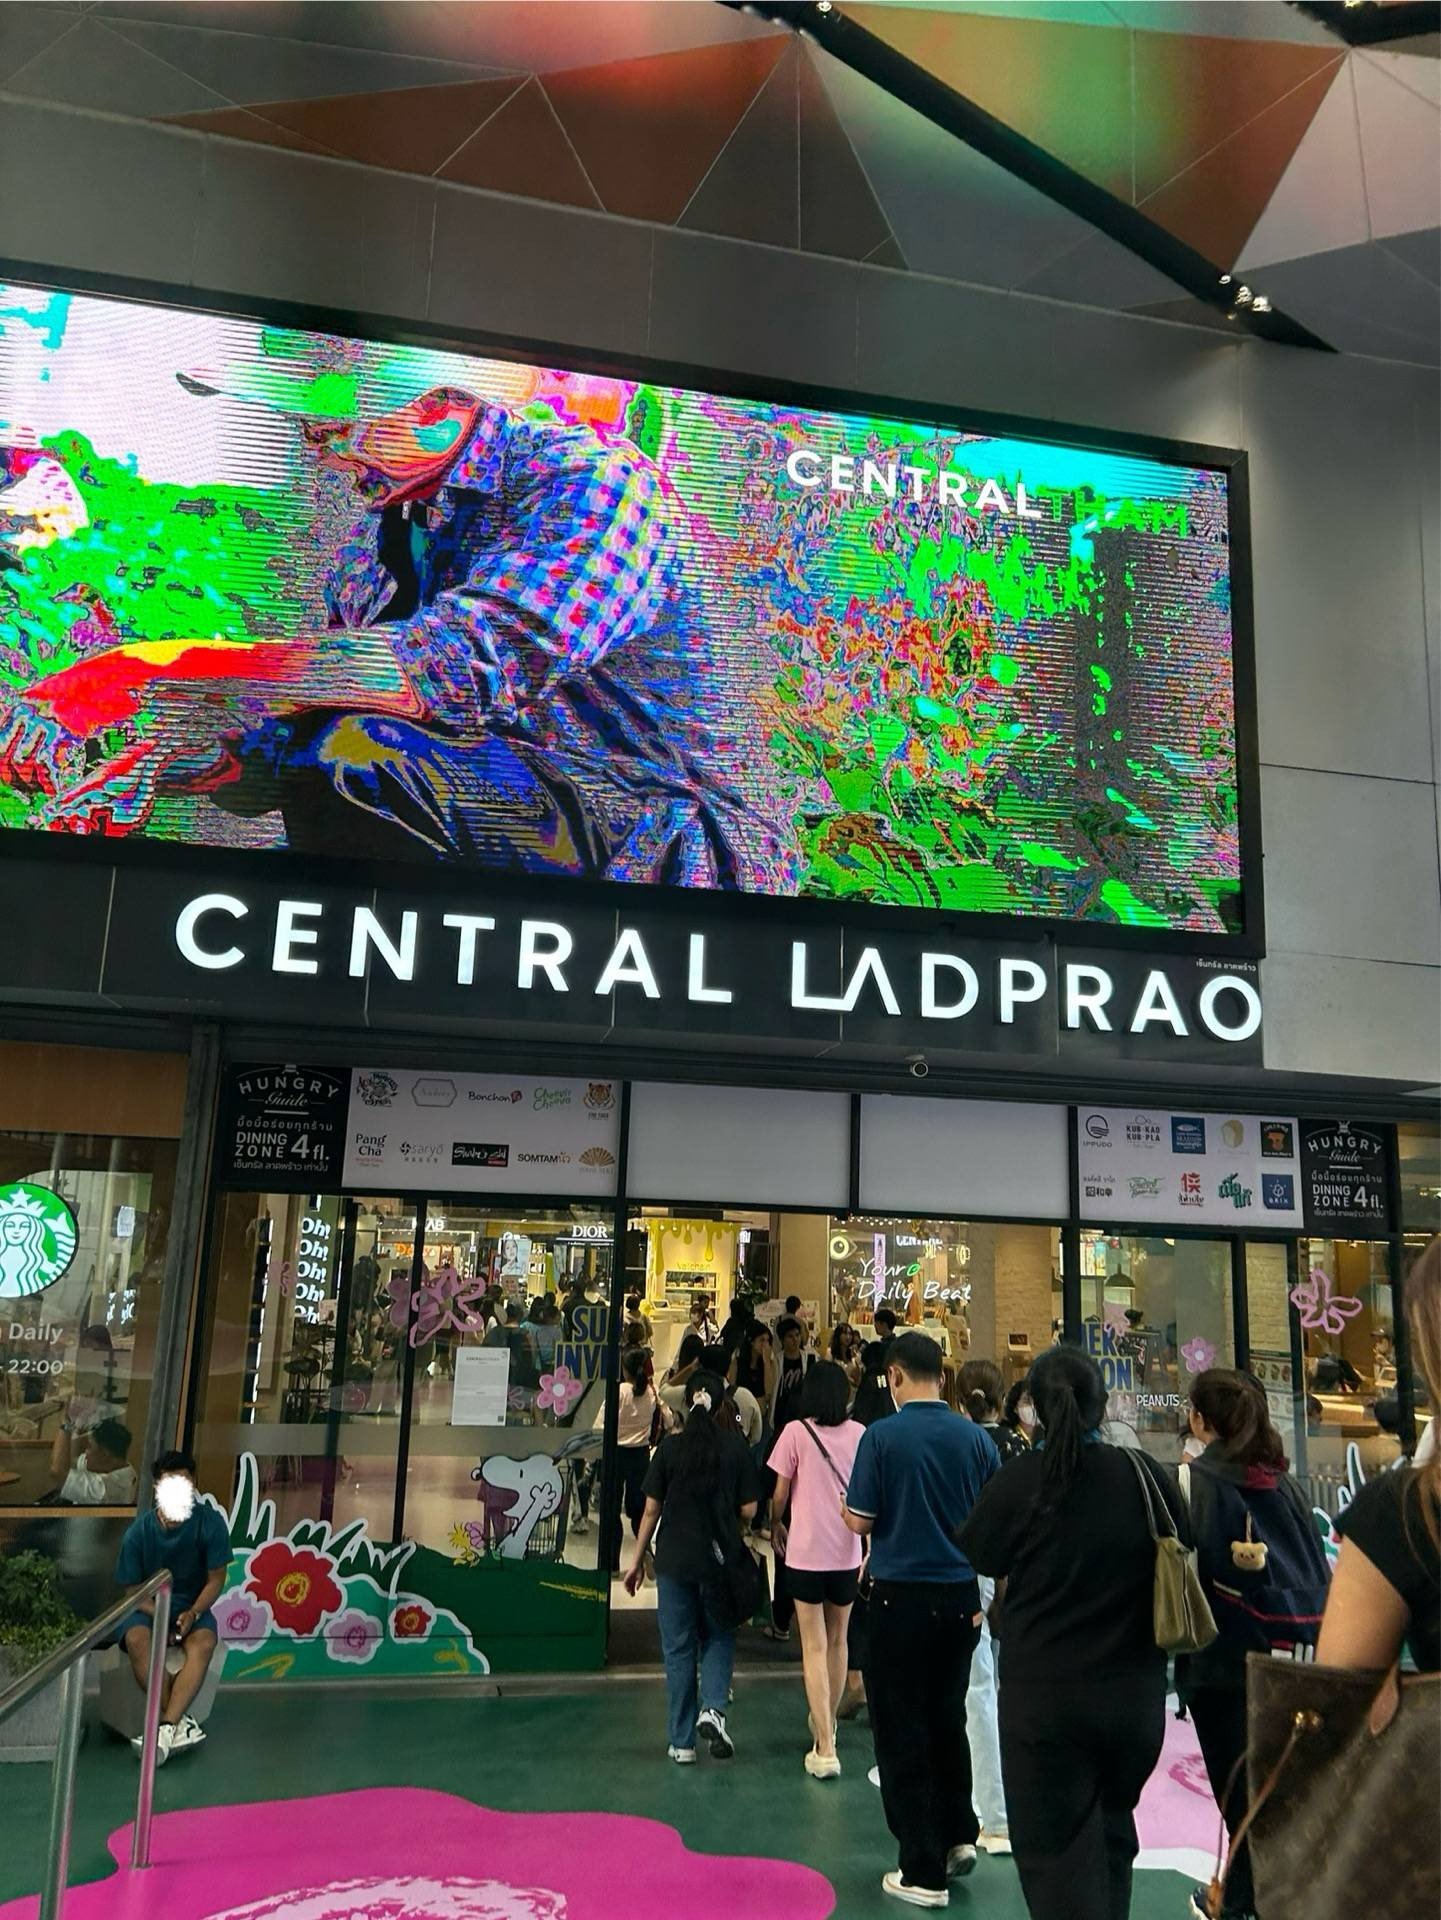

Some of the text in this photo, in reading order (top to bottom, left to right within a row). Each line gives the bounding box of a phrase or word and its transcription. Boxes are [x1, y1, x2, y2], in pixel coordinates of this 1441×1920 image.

[786, 450, 1041, 519] CENTRAL
[175, 893, 1262, 1042] CENTRAL LADPRAO
[239, 1076, 339, 1098] HUNGRY
[265, 1091, 308, 1106] Guide
[468, 1091, 511, 1103] Bonchon
[236, 1131, 288, 1145] DINING
[291, 1134, 310, 1159] 4
[355, 1133, 387, 1148] Pang
[1308, 1136, 1382, 1154] HUNGRY
[234, 1145, 285, 1158] ZONE
[358, 1145, 382, 1157] Cha
[1329, 1150, 1361, 1162] Guide
[1312, 1184, 1351, 1196] DINING
[1353, 1185, 1369, 1208] 4
[1313, 1195, 1350, 1207] ZONE
[302, 1217, 331, 1240] Oh!
[571, 1224, 608, 1238] DIOR
[299, 1239, 329, 1262] Oh!
[297, 1261, 327, 1284] Oh!
[860, 1257, 906, 1276] Your
[858, 1280, 971, 1309] Daily Beat
[9, 1322, 64, 1345] Daily
[7, 1358, 64, 1375] 22:00
[1136, 1394, 1180, 1408] PEANUTS
